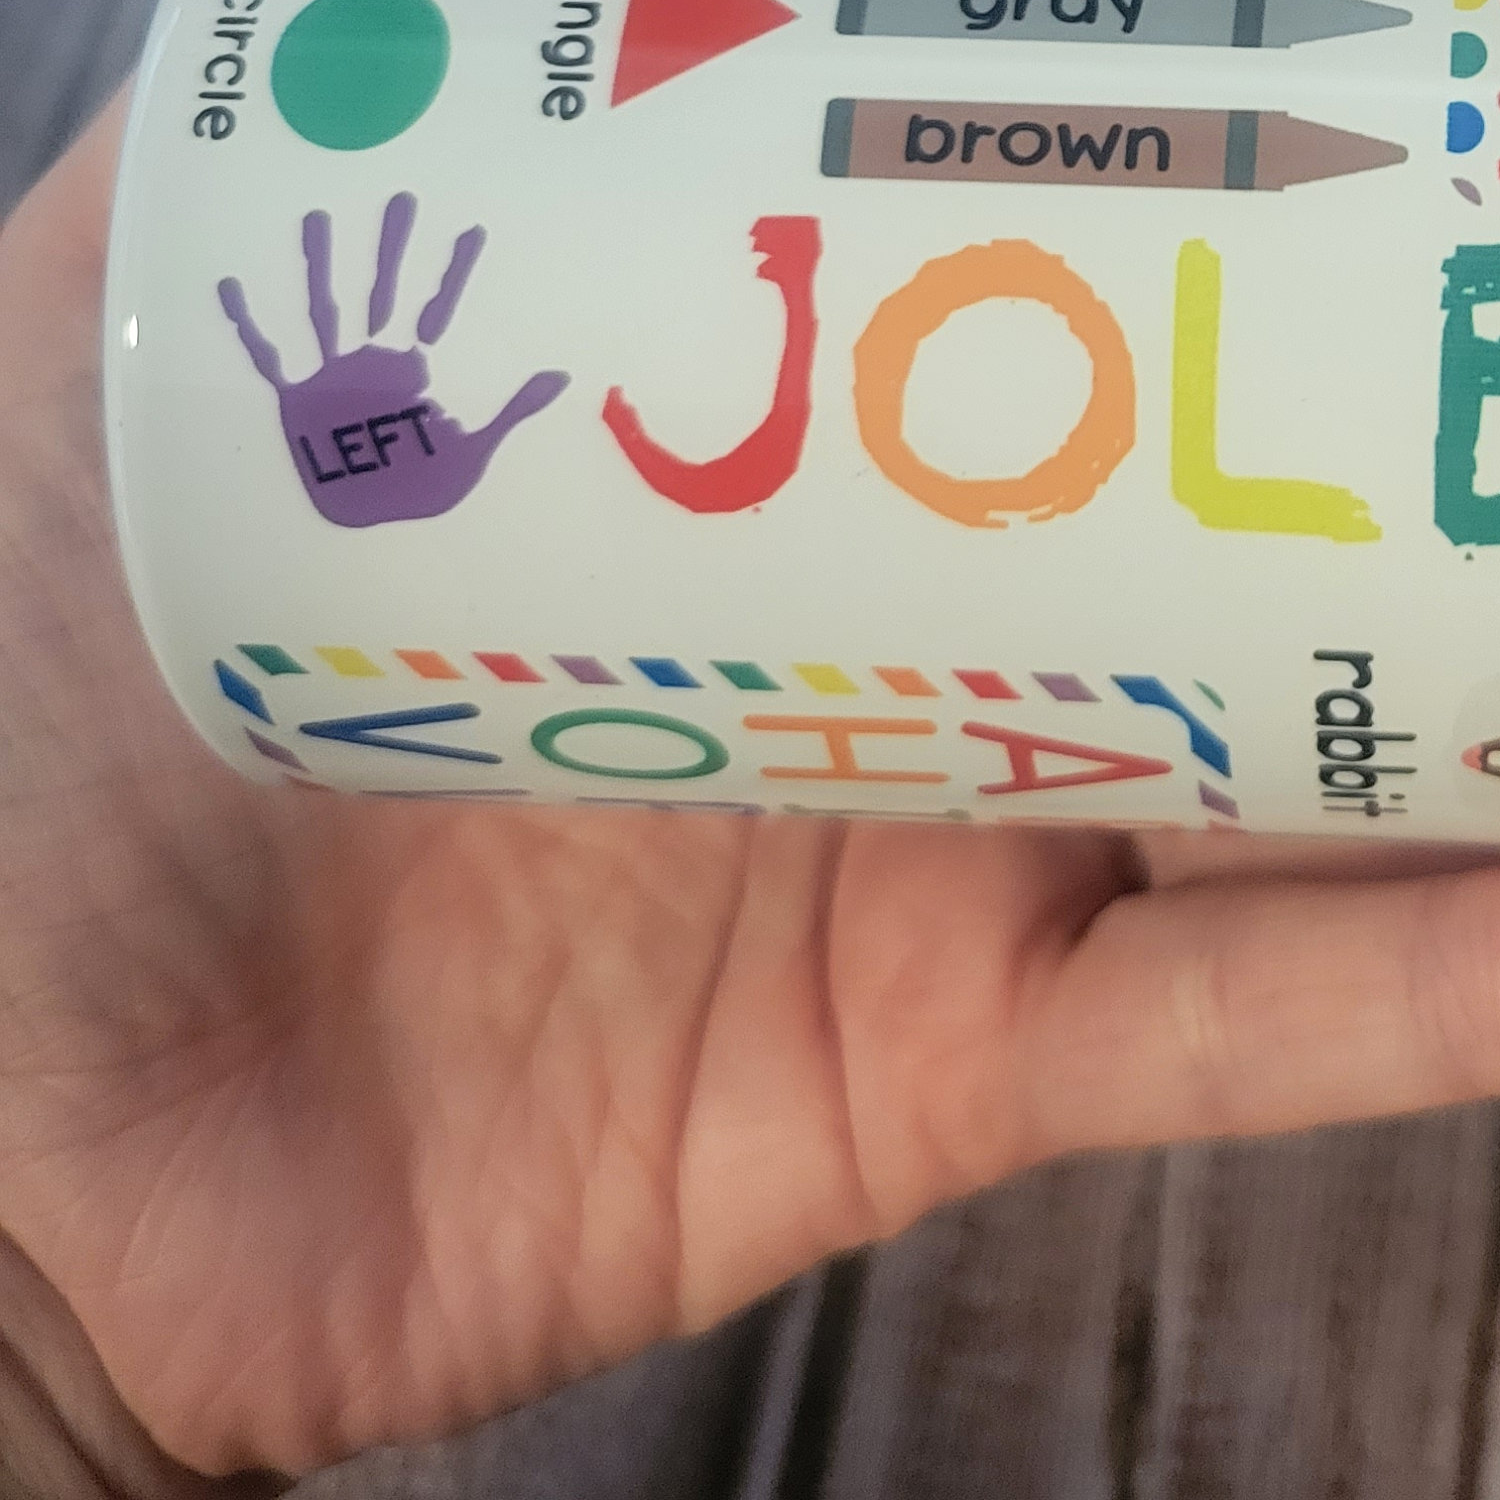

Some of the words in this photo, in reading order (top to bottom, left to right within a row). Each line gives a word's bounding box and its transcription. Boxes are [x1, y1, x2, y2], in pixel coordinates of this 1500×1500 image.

[904, 113, 1171, 172] brown
[300, 403, 435, 484] LEFT
[1312, 648, 1418, 818] rabbit
